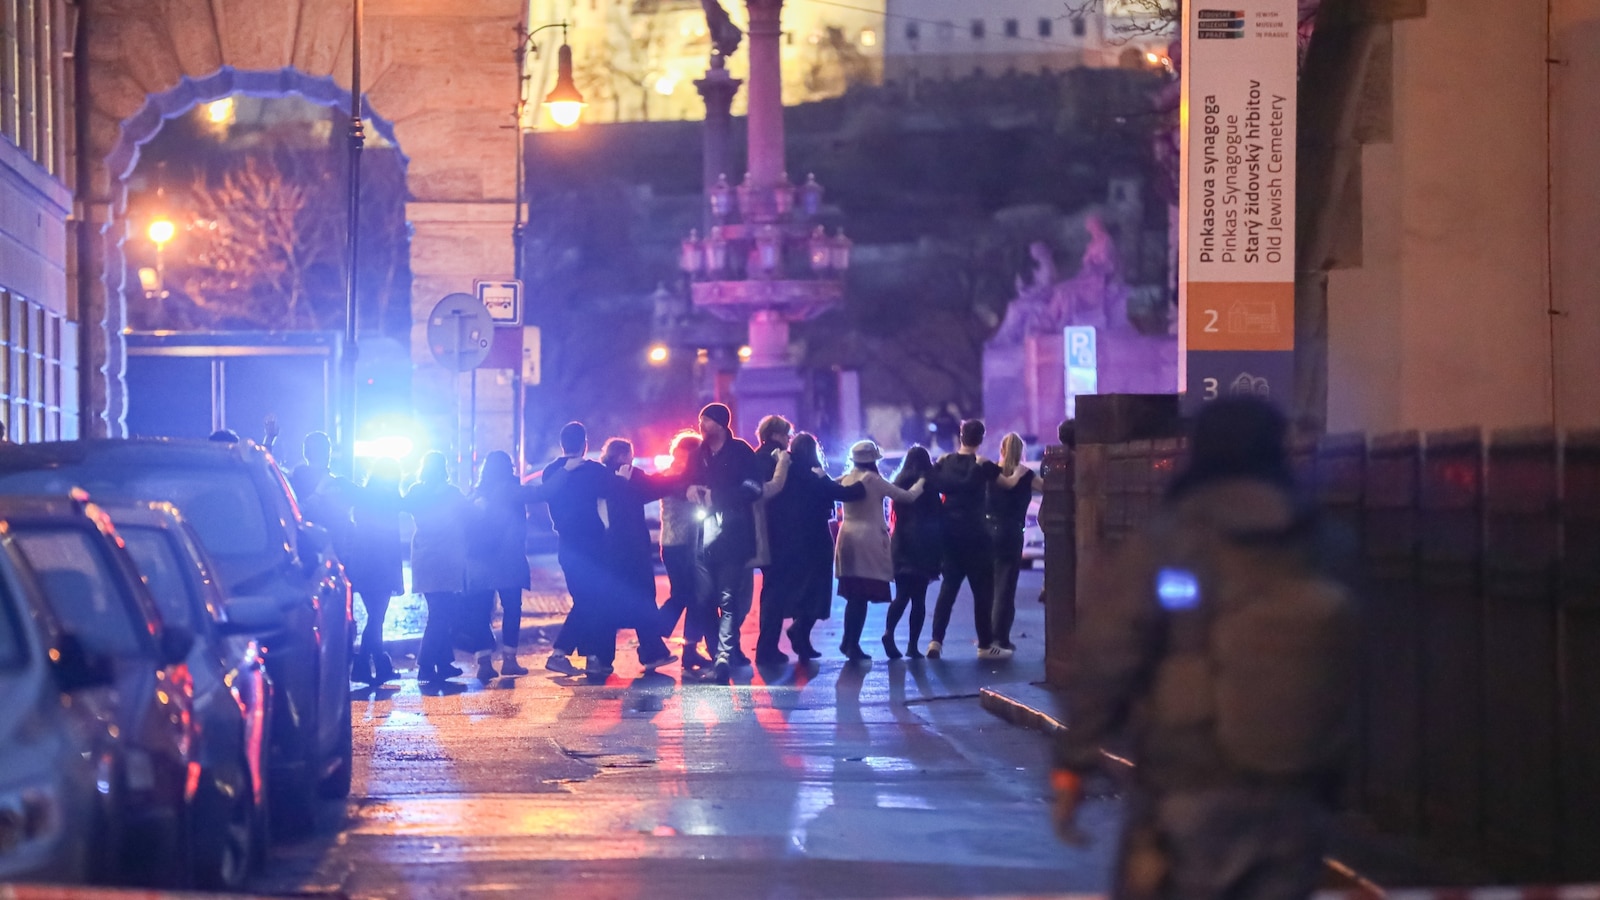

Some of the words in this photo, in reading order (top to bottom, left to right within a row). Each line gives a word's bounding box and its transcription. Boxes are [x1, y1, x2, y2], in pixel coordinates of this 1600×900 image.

[1204, 95, 1219, 174] synagoga
[1245, 80, 1260, 138] hřbitov
[1268, 95, 1286, 173] Cemetery
[1223, 115, 1241, 204] Synagogue
[1244, 144, 1263, 215] židovský
[1200, 179, 1214, 263] Pinkasova
[1267, 179, 1282, 231] Jewish
[1222, 210, 1236, 263] Pinkas
[1244, 220, 1263, 263] Starý
[1267, 237, 1281, 263] Old
[1072, 333, 1089, 355] P
[1204, 309, 1218, 332] 2
[1203, 377, 1218, 400] 3
